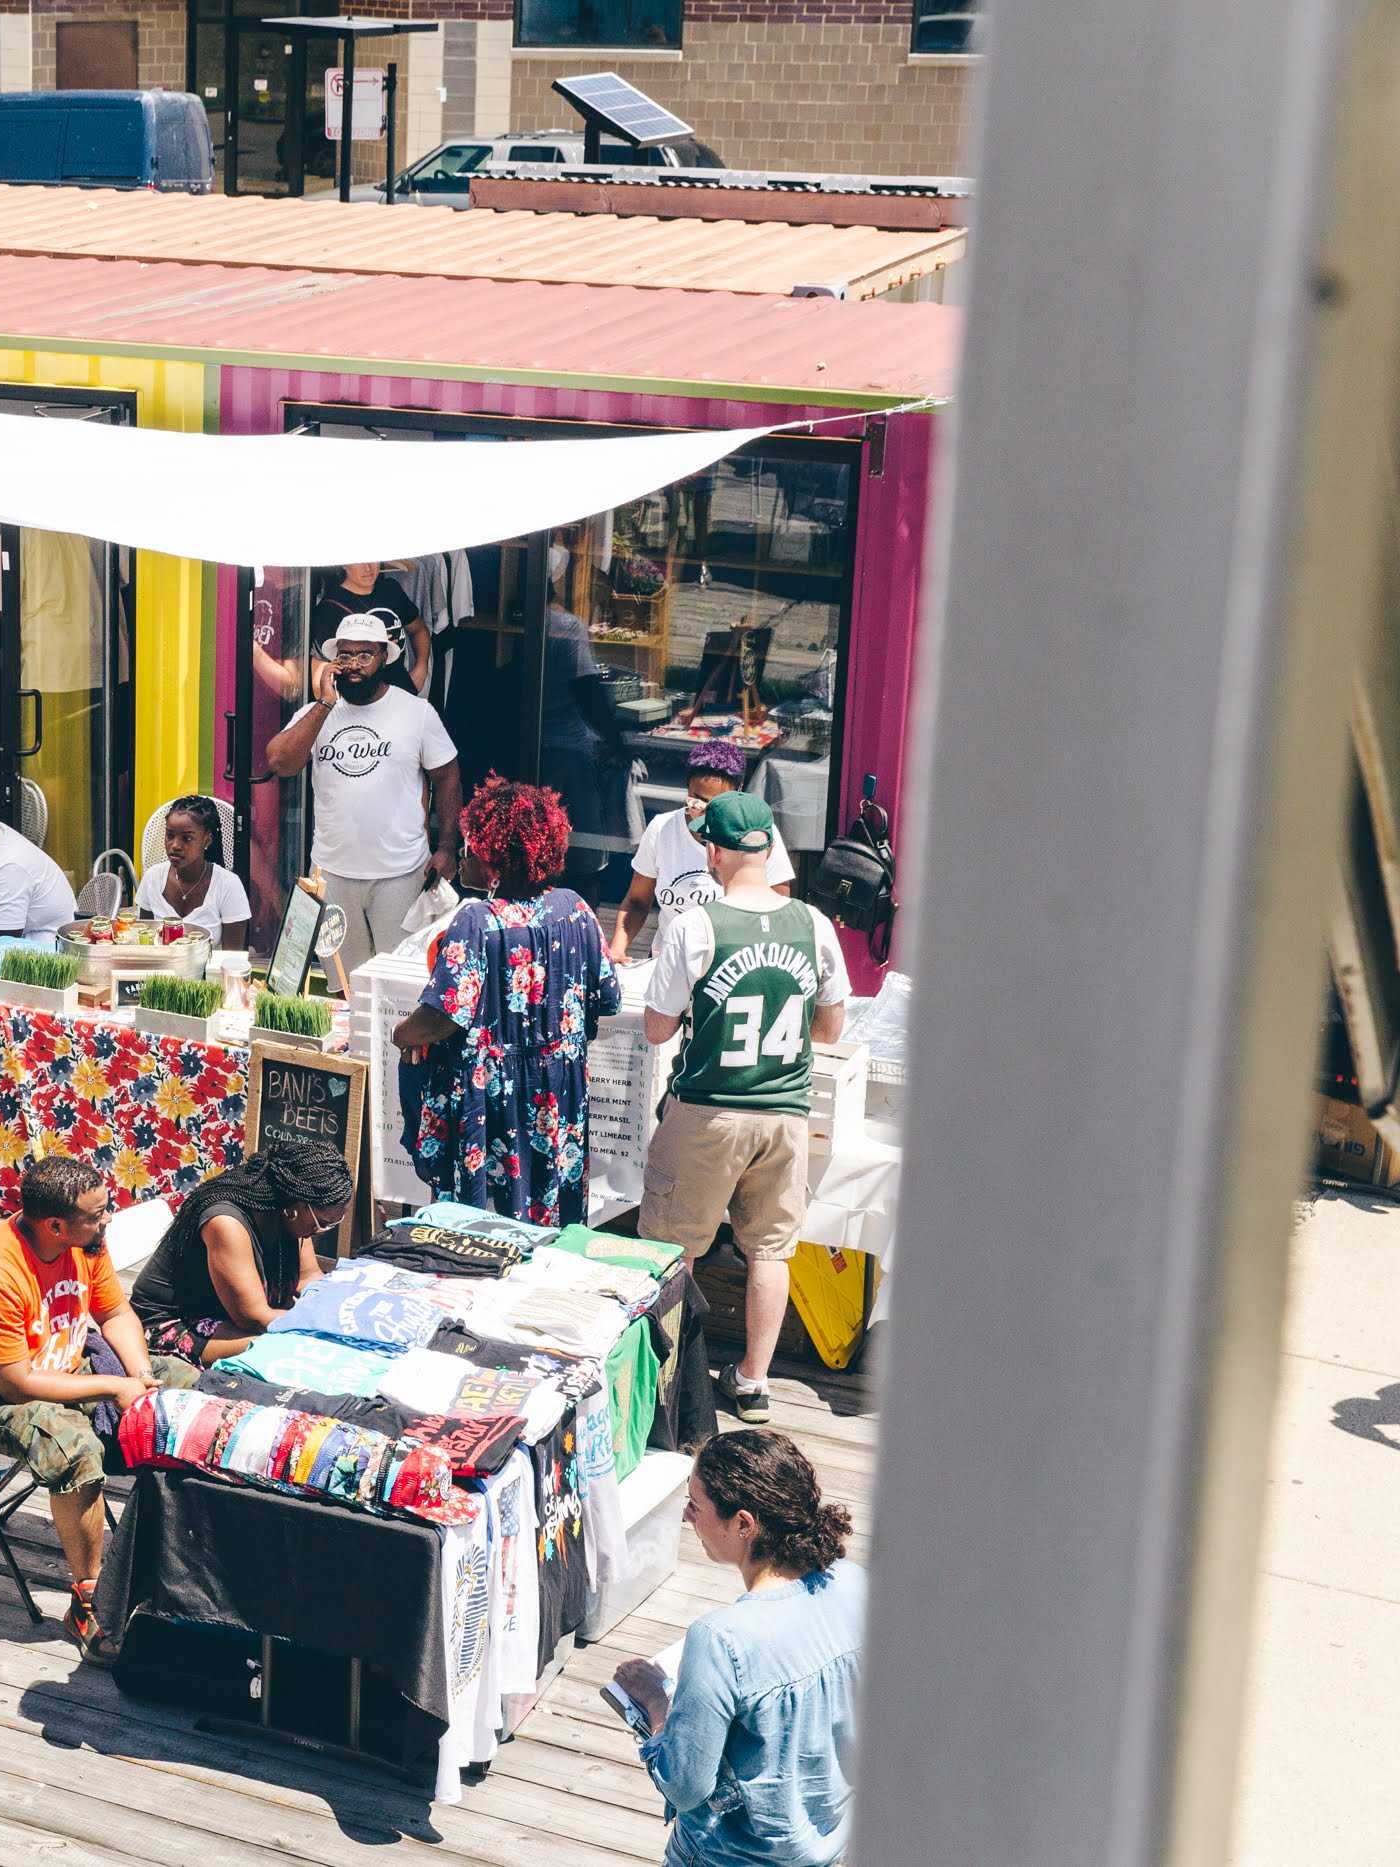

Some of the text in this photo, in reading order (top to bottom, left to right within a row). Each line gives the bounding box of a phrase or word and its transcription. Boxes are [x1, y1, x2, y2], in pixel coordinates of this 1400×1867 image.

[319, 741, 392, 762] Do Well
[660, 889, 685, 906] Do
[720, 995, 805, 1068] 34
[280, 1101, 339, 1135] BEETS
[609, 1116, 630, 1124] BASIL
[600, 1132, 632, 1141] LIMEADE
[600, 1148, 617, 1156] MEAL
